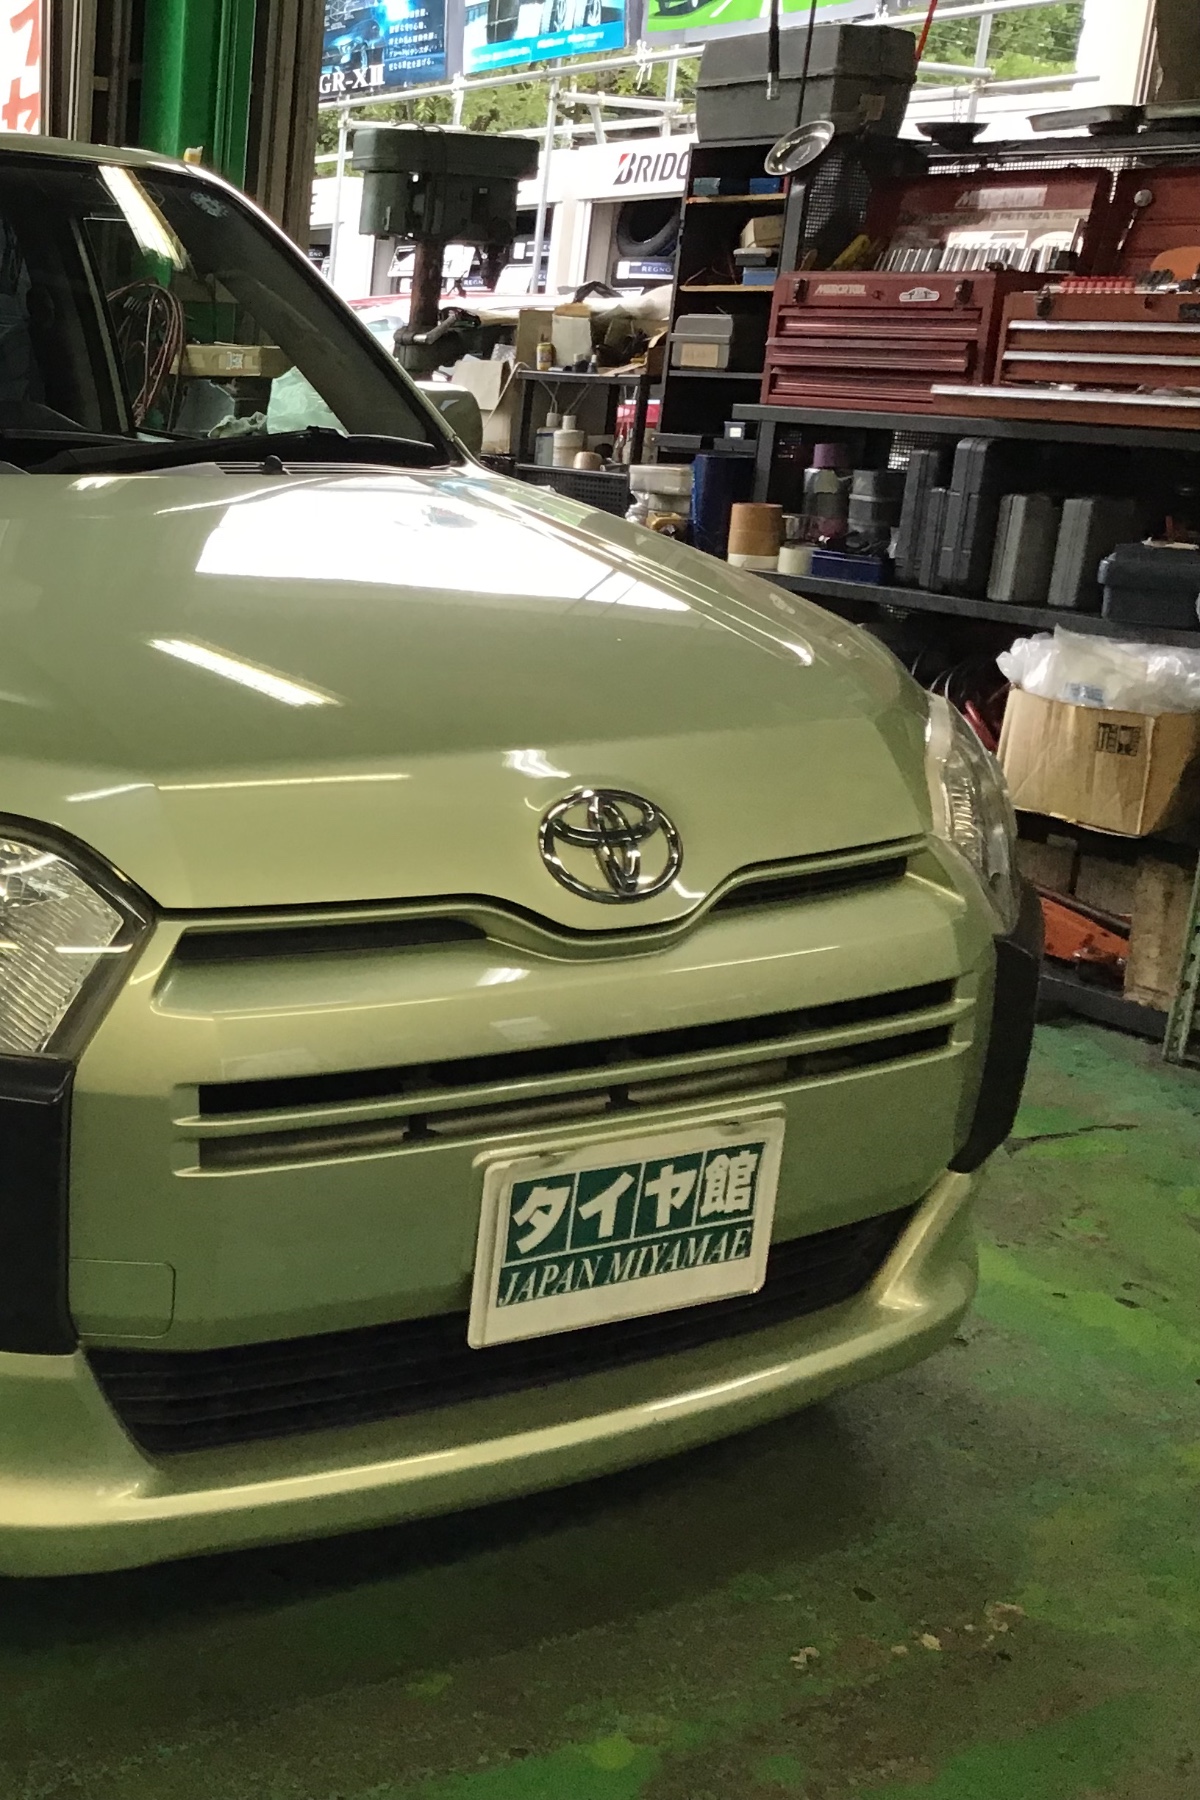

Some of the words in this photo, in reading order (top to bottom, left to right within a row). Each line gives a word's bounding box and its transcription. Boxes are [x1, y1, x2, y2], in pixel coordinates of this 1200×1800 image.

[641, 264, 672, 273] REGNO
[512, 1150, 759, 1254] タイヤ館
[498, 1254, 605, 1306] JAPAN
[602, 1226, 752, 1285] MIYAMAE
